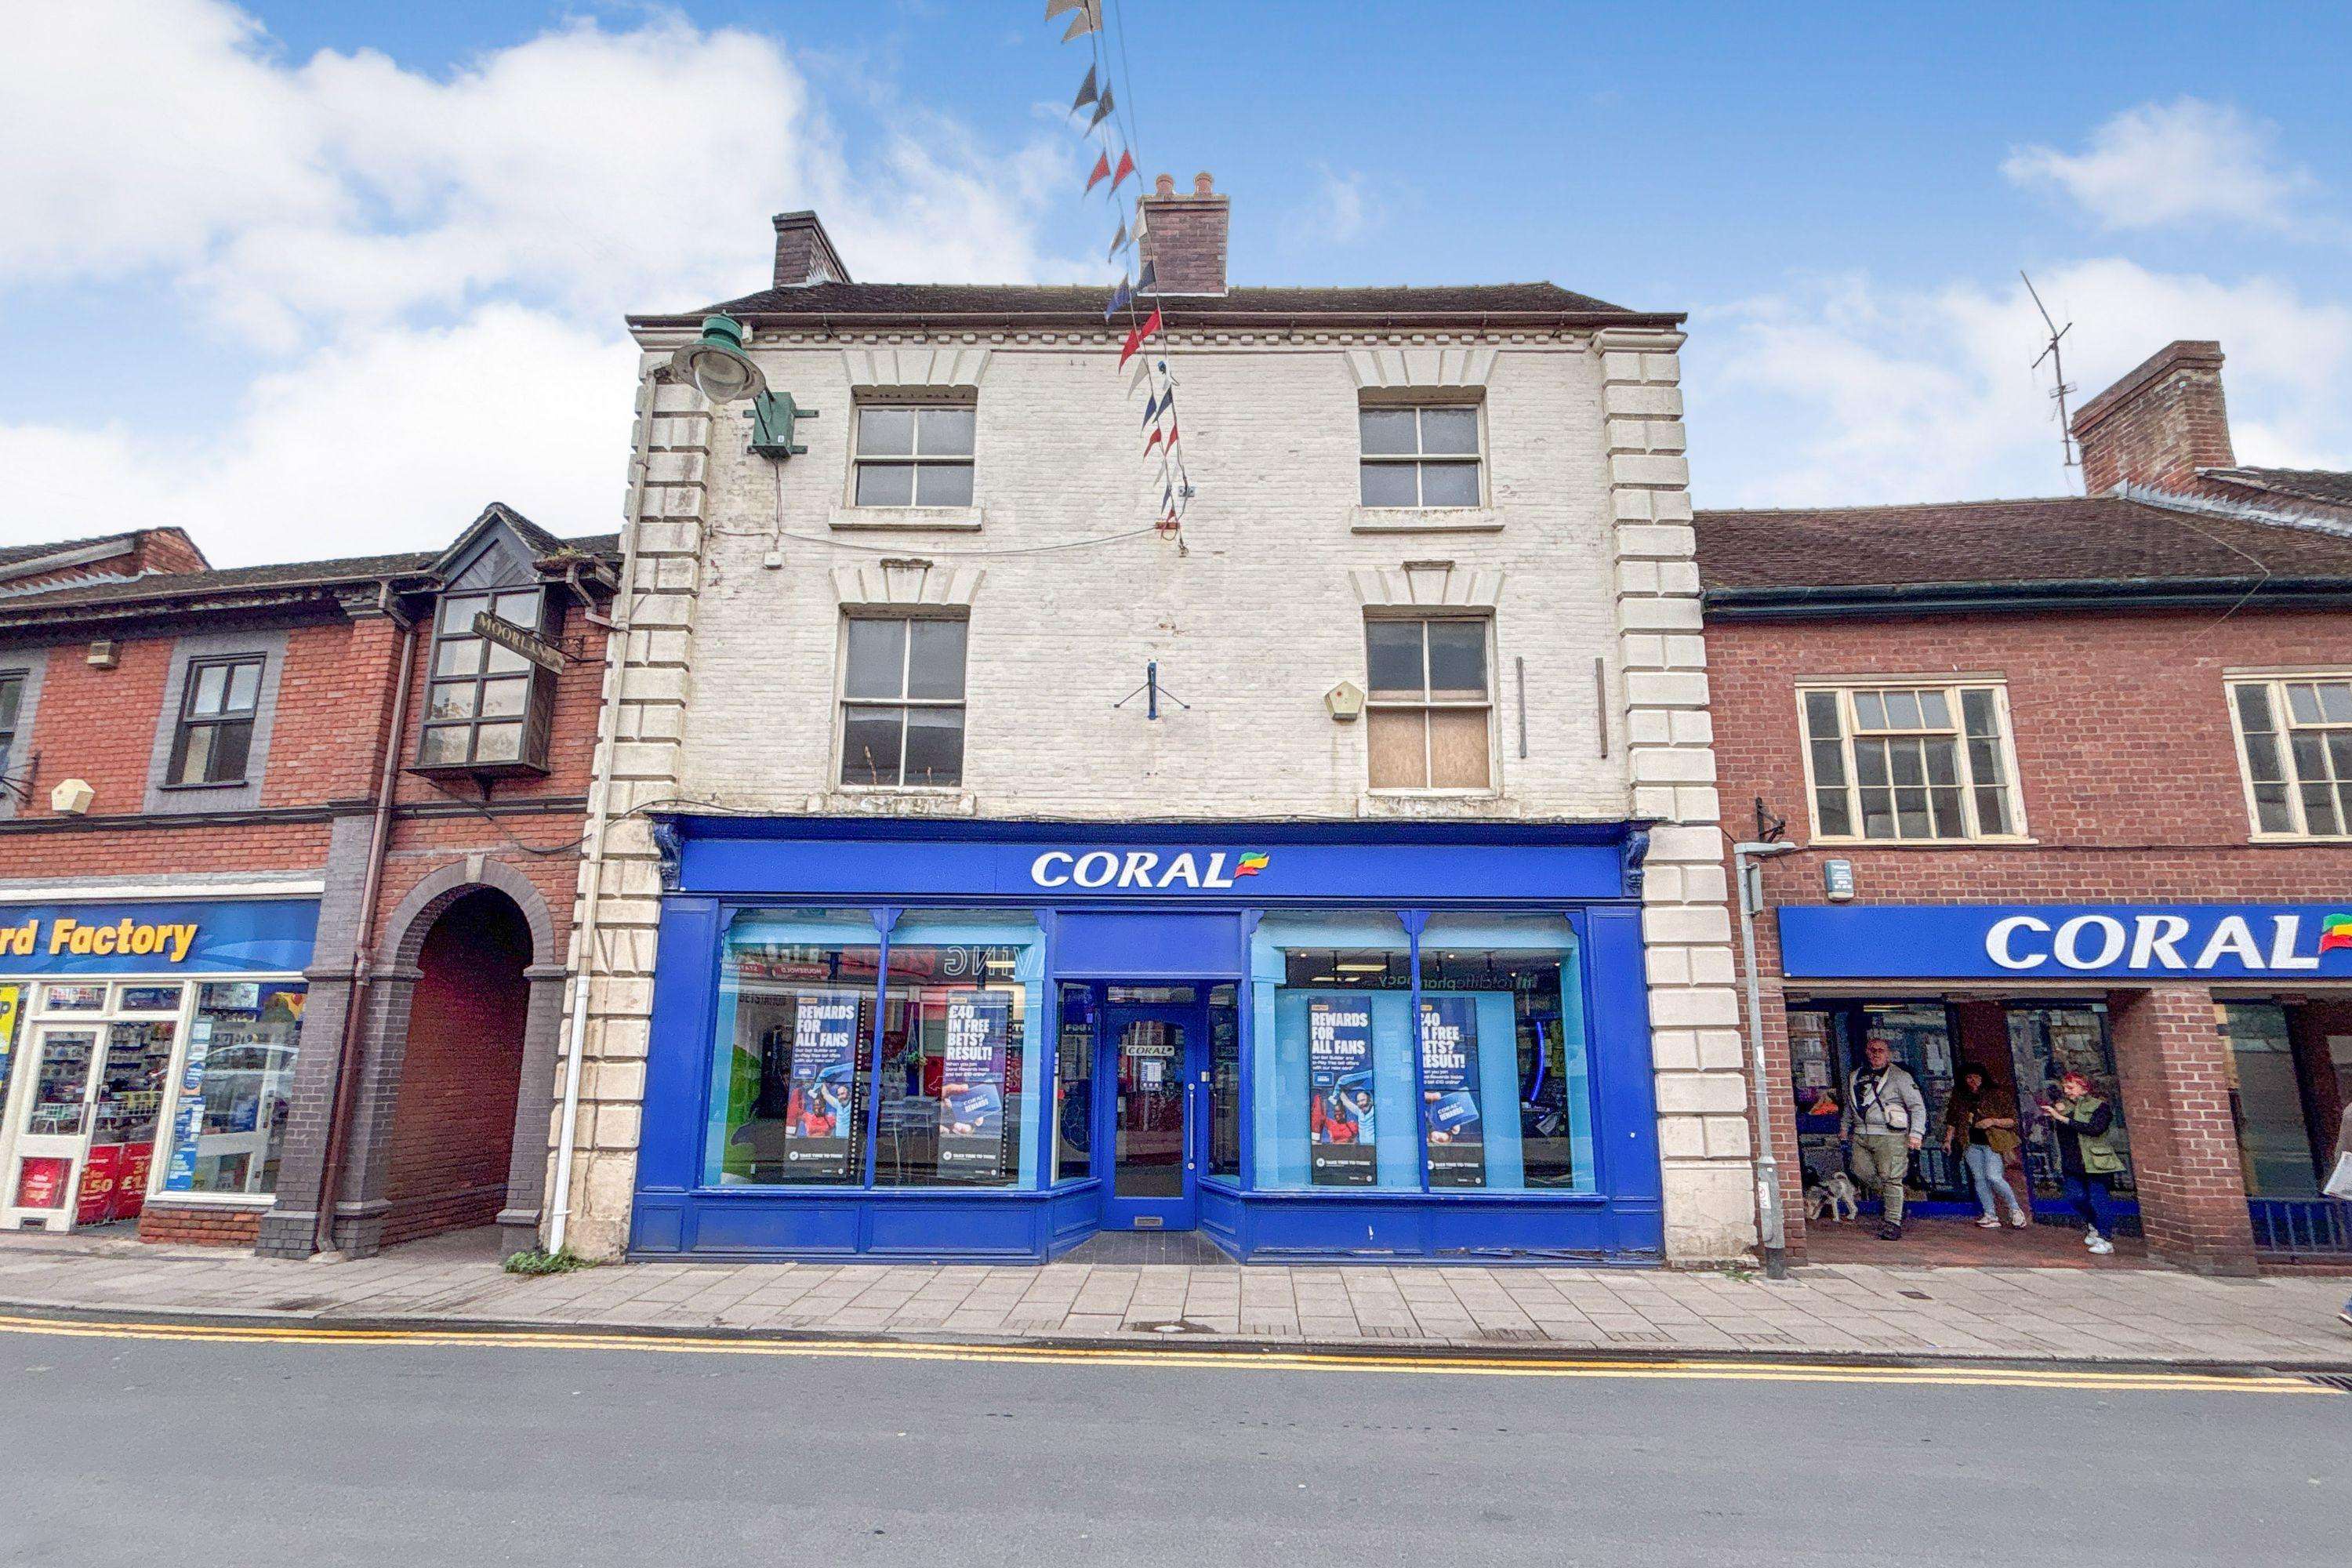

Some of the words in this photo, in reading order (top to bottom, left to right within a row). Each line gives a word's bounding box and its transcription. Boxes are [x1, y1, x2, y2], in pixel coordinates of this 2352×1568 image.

[1031, 851, 1233, 887] CORAL
[49, 918, 198, 962] Factory
[1985, 915, 2319, 969] CORAL
[797, 1005, 855, 1019] REWARDS
[949, 1005, 975, 1019] £40
[797, 1019, 821, 1033] FOR
[948, 1019, 961, 1033] IN
[964, 1019, 989, 1033] FREE
[1311, 1012, 1368, 1027] REWARDS
[795, 1033, 817, 1047] ALL
[819, 1033, 848, 1047] FANS
[947, 1033, 985, 1047] BETS?
[1312, 1026, 1334, 1040] FOR
[1431, 1026, 1459, 1040] FREE
[946, 1047, 993, 1061] RESULT!
[1127, 1046, 1167, 1055] CORAL
[1312, 1040, 1332, 1054] ALL
[1334, 1040, 1365, 1054] FANS
